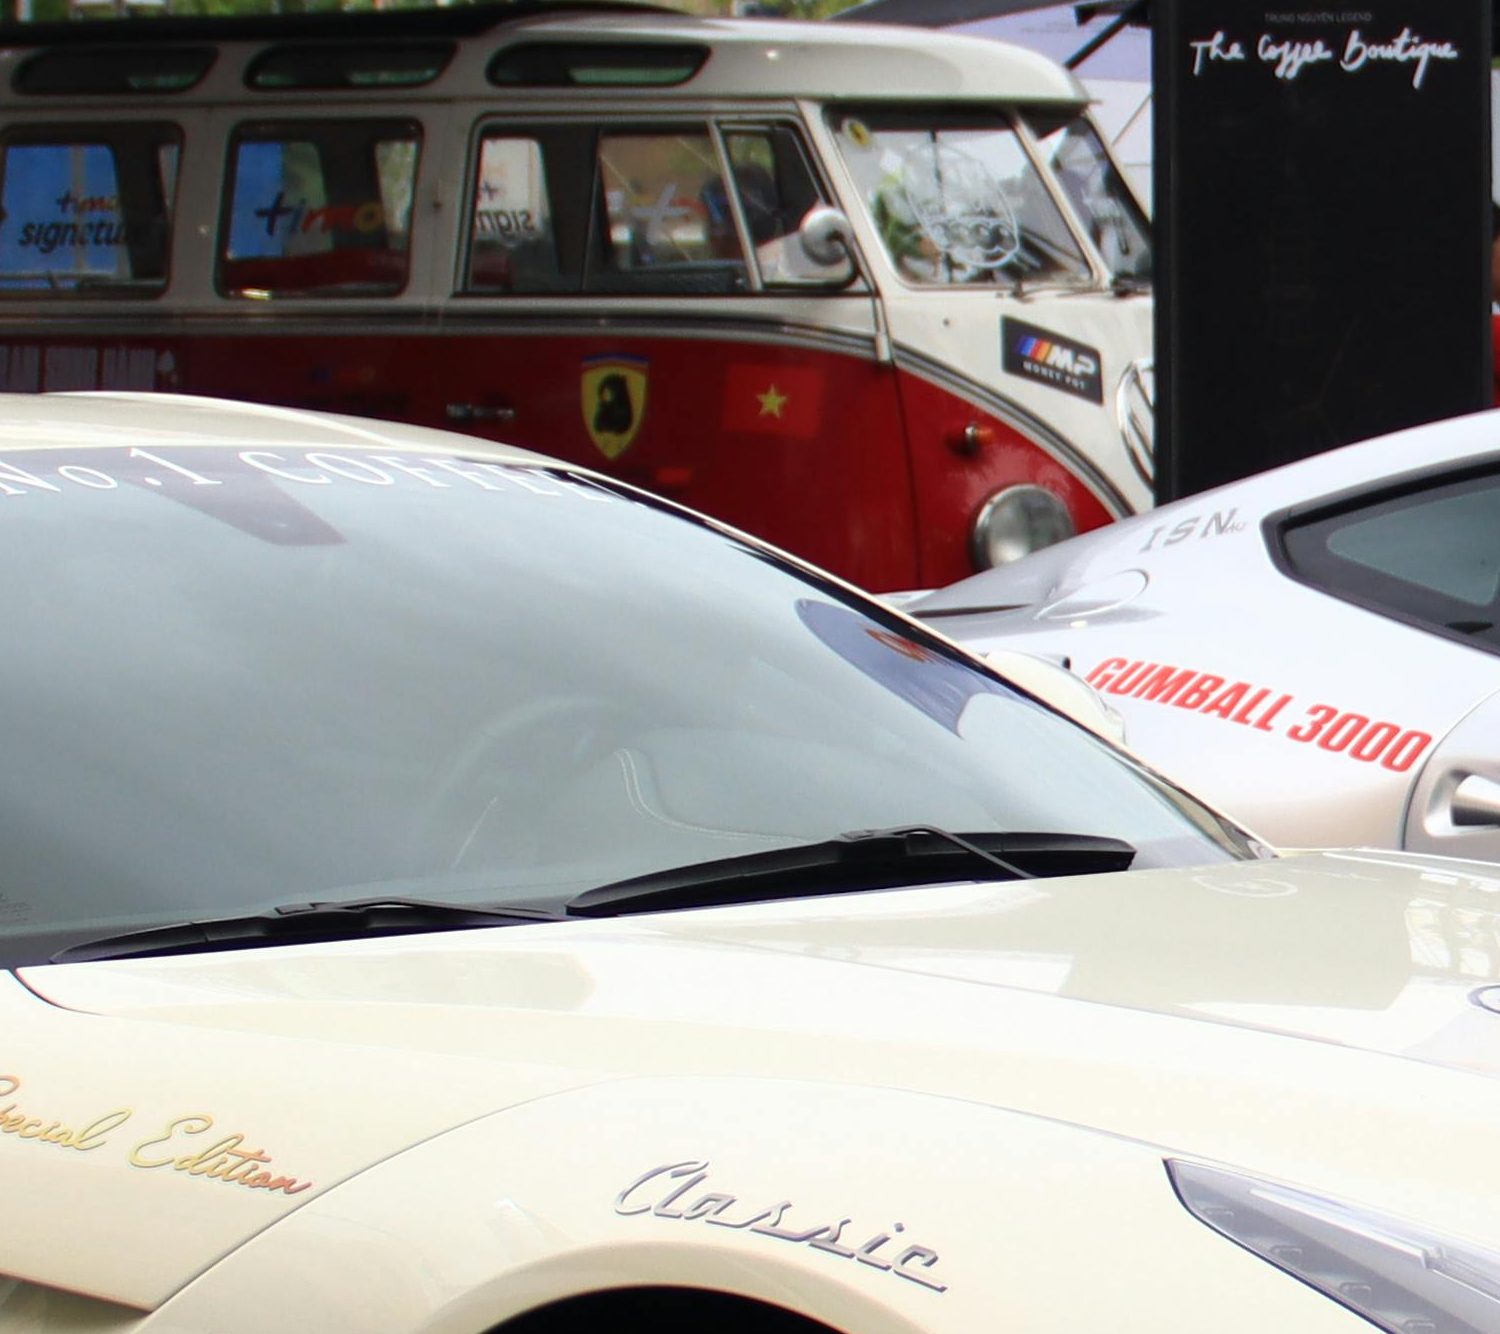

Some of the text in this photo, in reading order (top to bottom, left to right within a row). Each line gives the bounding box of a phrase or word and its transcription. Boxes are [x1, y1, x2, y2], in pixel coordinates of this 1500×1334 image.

[1190, 26, 1459, 90] The Coffee Boutique
[1084, 656, 1434, 774] GUMBALL 3000
[127, 1113, 314, 1196] Edition
[612, 1159, 949, 1295] Classic
